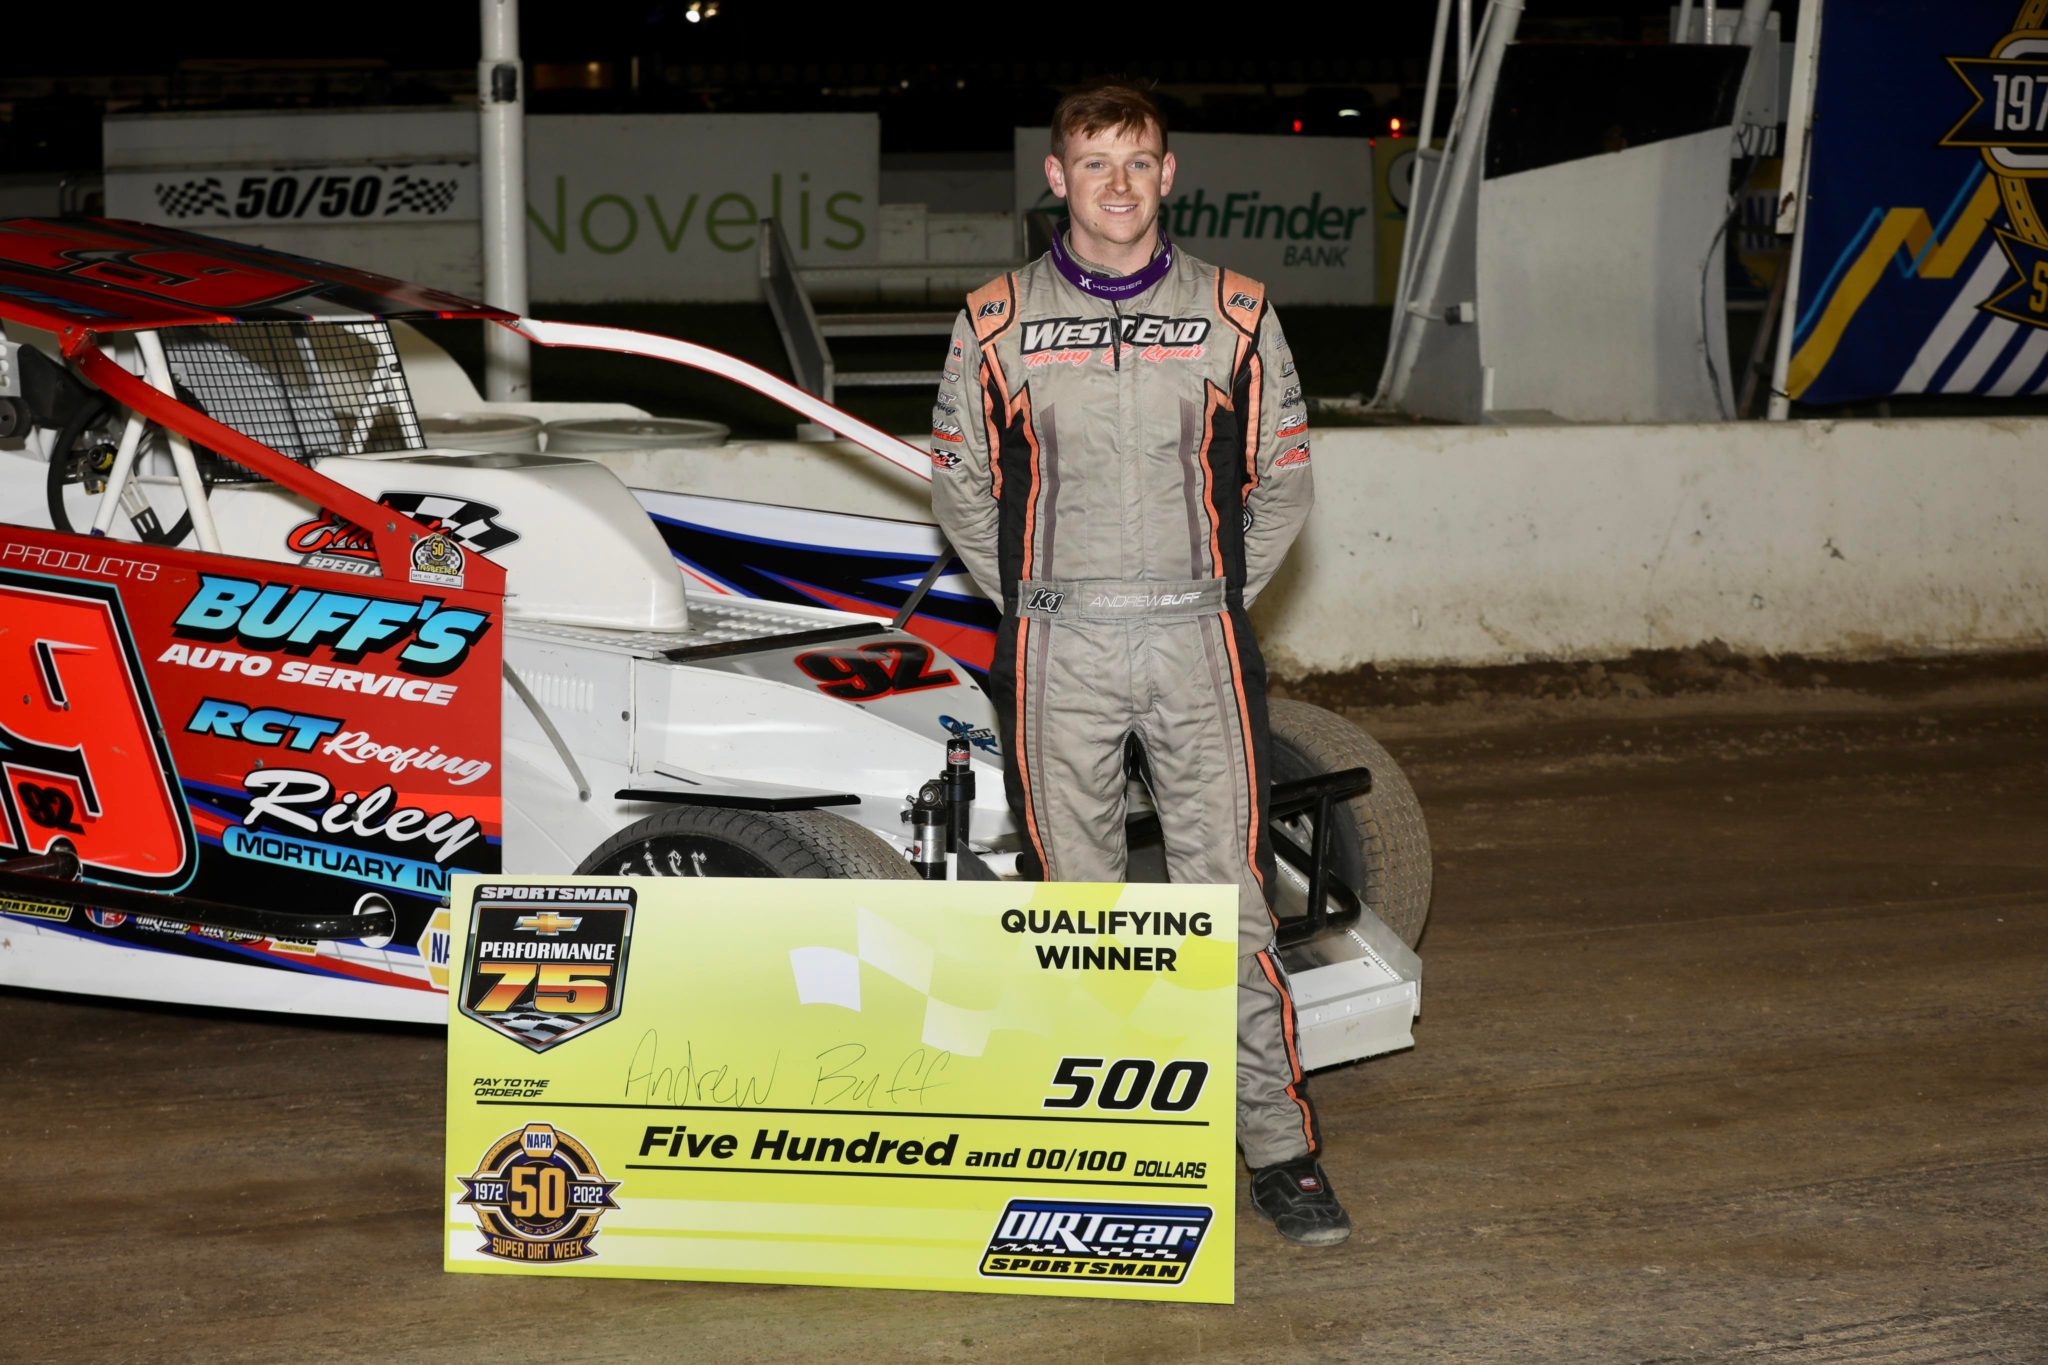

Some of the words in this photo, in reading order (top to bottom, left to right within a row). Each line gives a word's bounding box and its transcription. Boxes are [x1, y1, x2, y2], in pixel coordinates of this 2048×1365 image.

[235, 175, 382, 218] 50/50
[527, 172, 865, 254] Novelis
[1158, 189, 1367, 240] thFinder
[1284, 246, 1348, 267] BANK
[1092, 279, 1143, 292] HOOSIER
[978, 299, 1007, 320] K1
[1227, 292, 1258, 312] K1
[1134, 315, 1208, 344] END
[1023, 347, 1093, 368] Towing
[1140, 344, 1205, 363] Repair
[2, 543, 161, 581] PRODUCTS
[432, 542, 444, 556] 50
[305, 556, 366, 576] SPEED
[1027, 588, 1065, 613] K1
[173, 573, 490, 670] BUFF'S
[157, 643, 273, 678] AUTO
[277, 661, 459, 706] SERVICE
[794, 641, 961, 702] 92
[187, 700, 343, 750] RCT
[323, 731, 492, 785] Roofing
[243, 769, 481, 862] Riley
[236, 833, 403, 882] MORTUARY
[416, 867, 451, 892] IN
[480, 886, 630, 902] SPORTSMAN
[1000, 909, 1213, 937] QUALIFYING
[479, 941, 616, 961] PERFORMANCE
[1035, 945, 1177, 972] WINNER
[473, 962, 615, 1014] 75
[625, 1028, 781, 1108] Andrew
[811, 1042, 955, 1109] Buff
[473, 1078, 502, 1088] PAY
[503, 1078, 521, 1088] TO
[523, 1079, 550, 1089] THE
[474, 1088, 521, 1098] ORDER
[523, 1088, 544, 1098] OF
[1042, 1056, 1211, 1112] 500
[526, 1133, 552, 1149] NAPA
[639, 1125, 737, 1159] Five
[751, 1129, 959, 1166] Hundred
[965, 1148, 1020, 1169] and
[1026, 1148, 1127, 1172] 00/100
[1134, 1160, 1207, 1179] DOLLARS
[474, 1183, 503, 1201] 1972
[510, 1166, 566, 1218] 50
[573, 1186, 603, 1204] 2022
[513, 1219, 564, 1234] YEARS
[998, 1210, 1203, 1253] DIRTcar
[492, 1237, 524, 1258] SUPER
[528, 1243, 549, 1259] DIRT
[553, 1240, 583, 1258] WEEK
[989, 1257, 1180, 1279] SPORTSMAN
